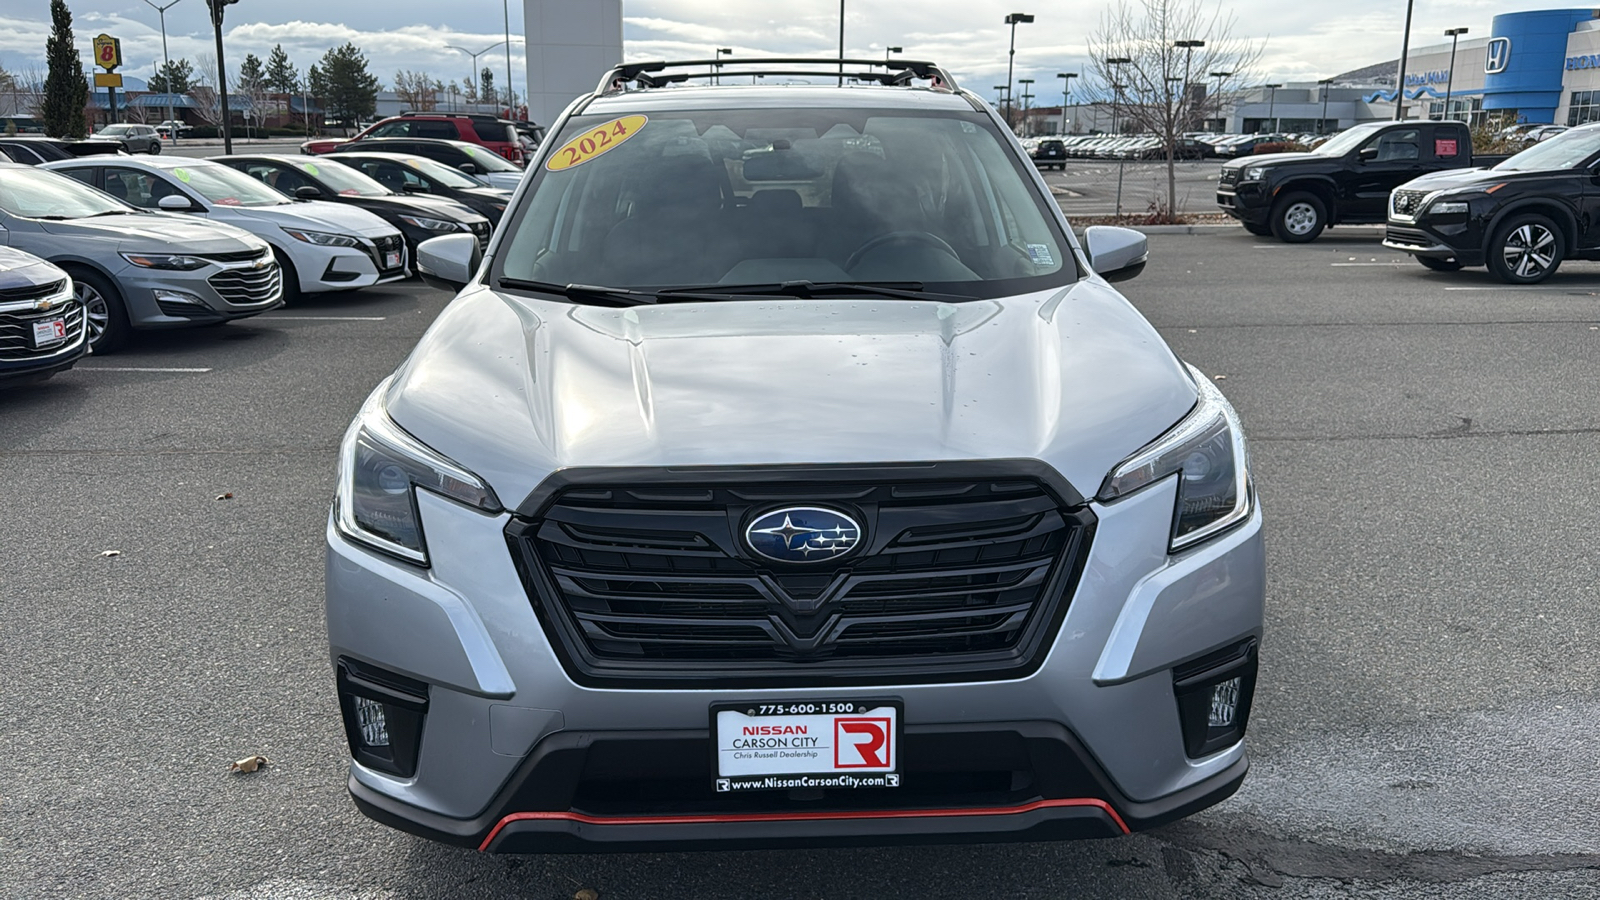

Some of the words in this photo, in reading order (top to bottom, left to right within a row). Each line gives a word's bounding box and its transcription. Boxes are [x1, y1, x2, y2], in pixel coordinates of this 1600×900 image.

[101, 45, 114, 61] 8
[562, 120, 627, 166] 2024
[759, 703, 854, 715] 775-600-1500
[742, 725, 808, 736] NISSAN
[732, 738, 788, 749] CARSON
[791, 737, 819, 748] CITY
[733, 751, 752, 760] Chris
[754, 751, 778, 759] Russell
[779, 750, 818, 760] Dealership
[731, 775, 885, 790] www.NissanCarsonCity.com
